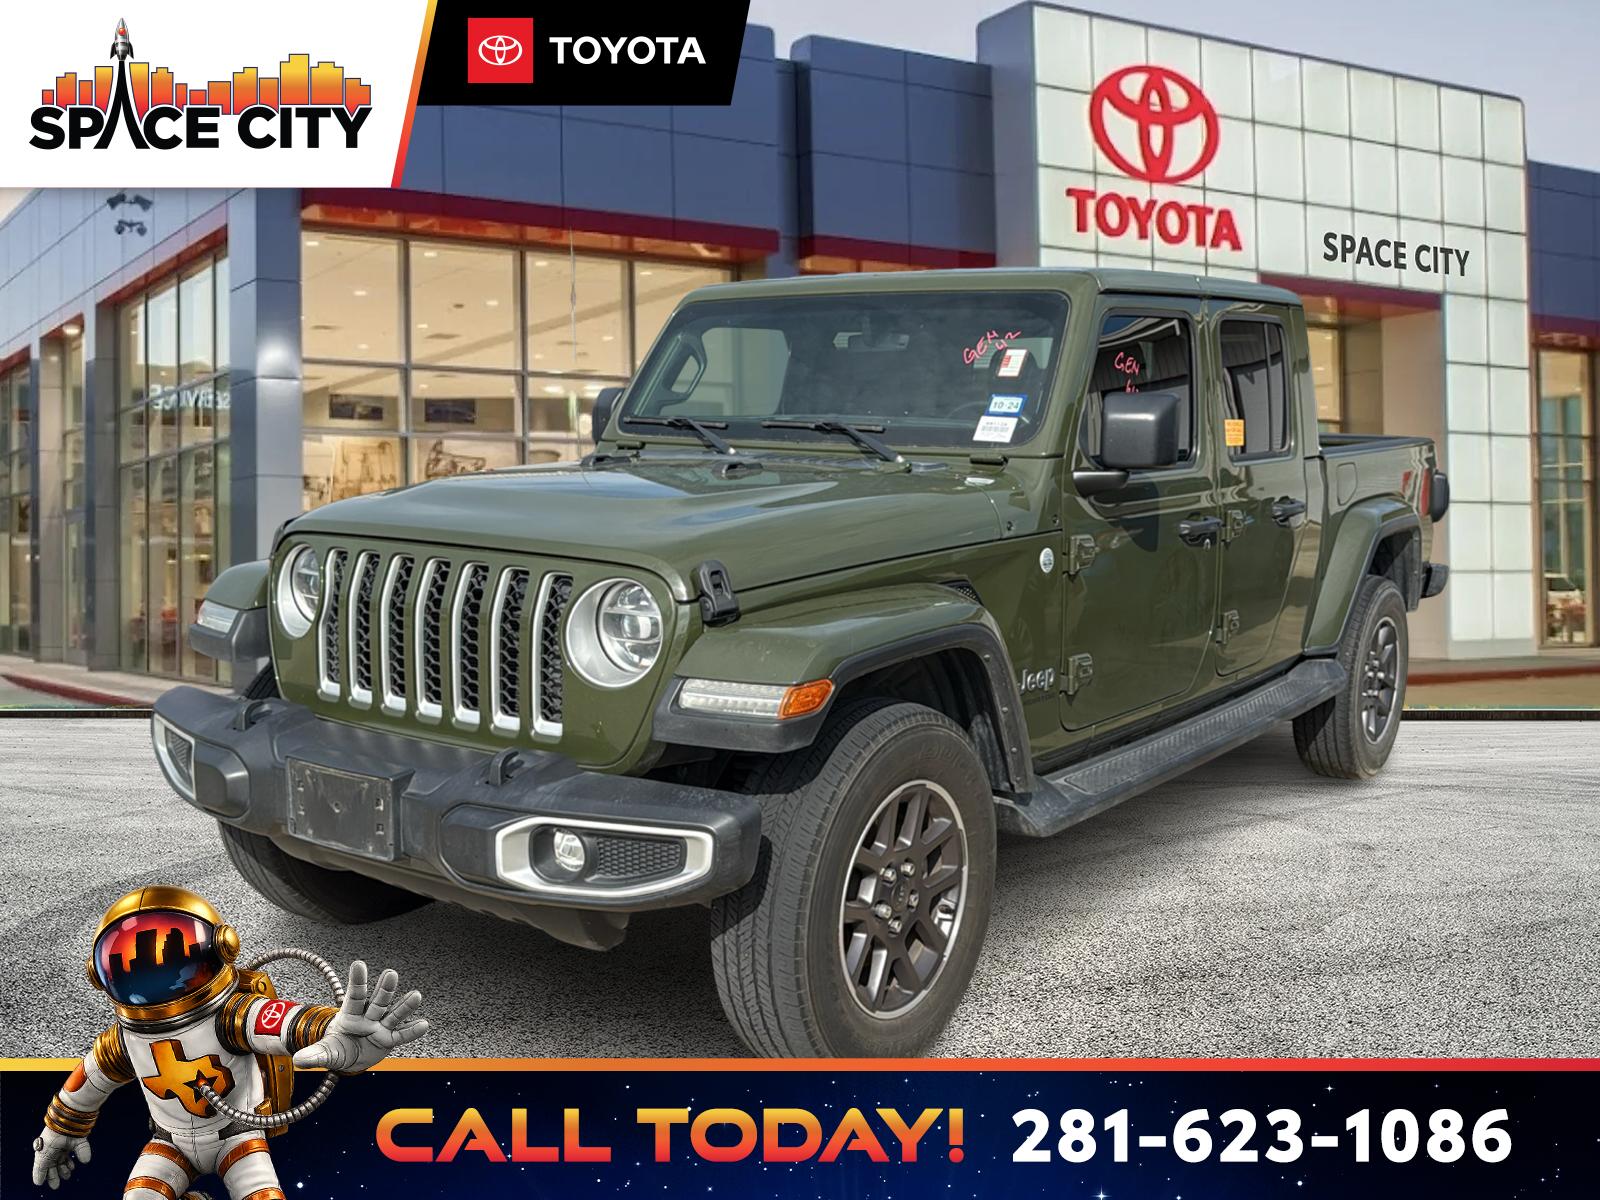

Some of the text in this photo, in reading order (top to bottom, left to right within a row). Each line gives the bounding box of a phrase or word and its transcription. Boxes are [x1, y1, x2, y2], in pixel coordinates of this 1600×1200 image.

[1066, 188, 1243, 251] TOYOTA
[1323, 232, 1470, 277] SPACE CITY
[1021, 667, 1055, 692] Jeep
